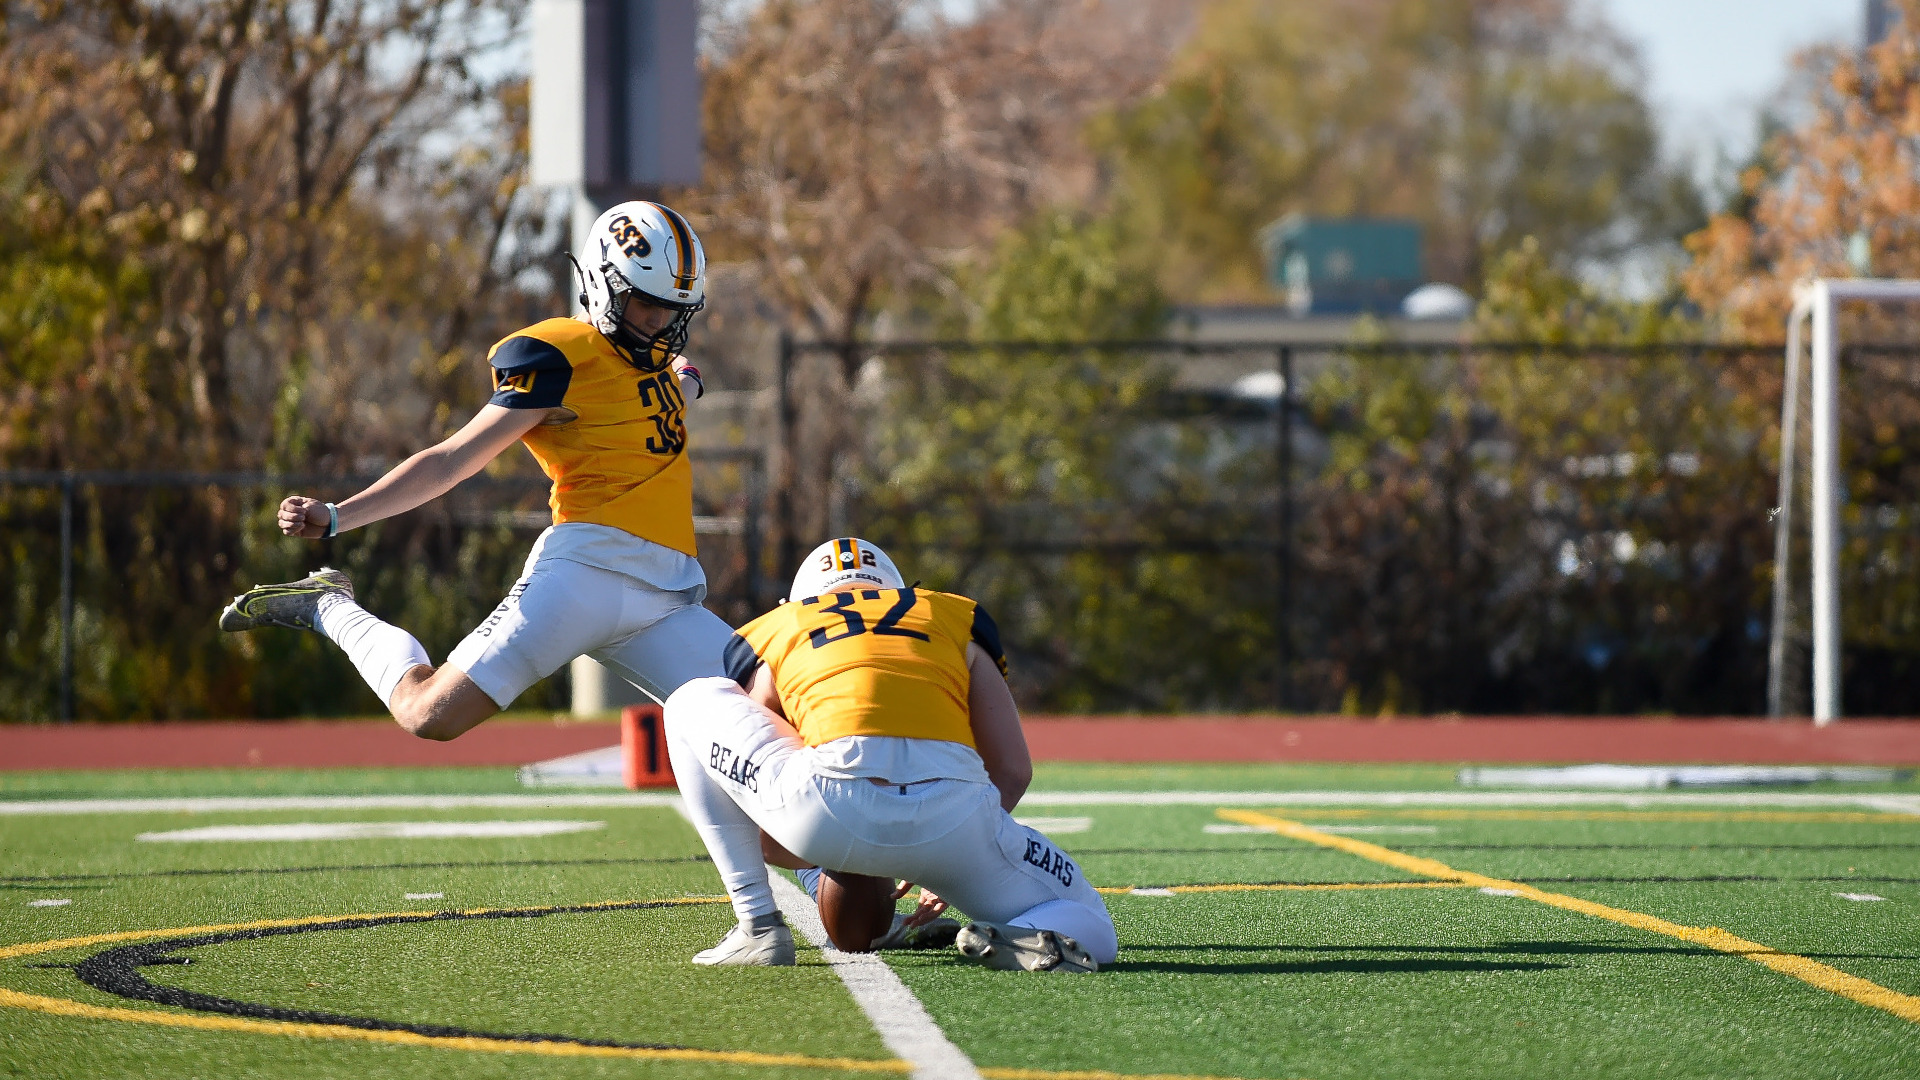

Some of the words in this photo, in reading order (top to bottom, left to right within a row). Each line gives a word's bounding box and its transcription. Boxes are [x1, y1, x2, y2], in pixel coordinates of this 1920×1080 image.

[608, 214, 652, 259] CSP
[637, 370, 685, 455] 30
[801, 586, 931, 649] 32
[710, 741, 761, 793] BEARS
